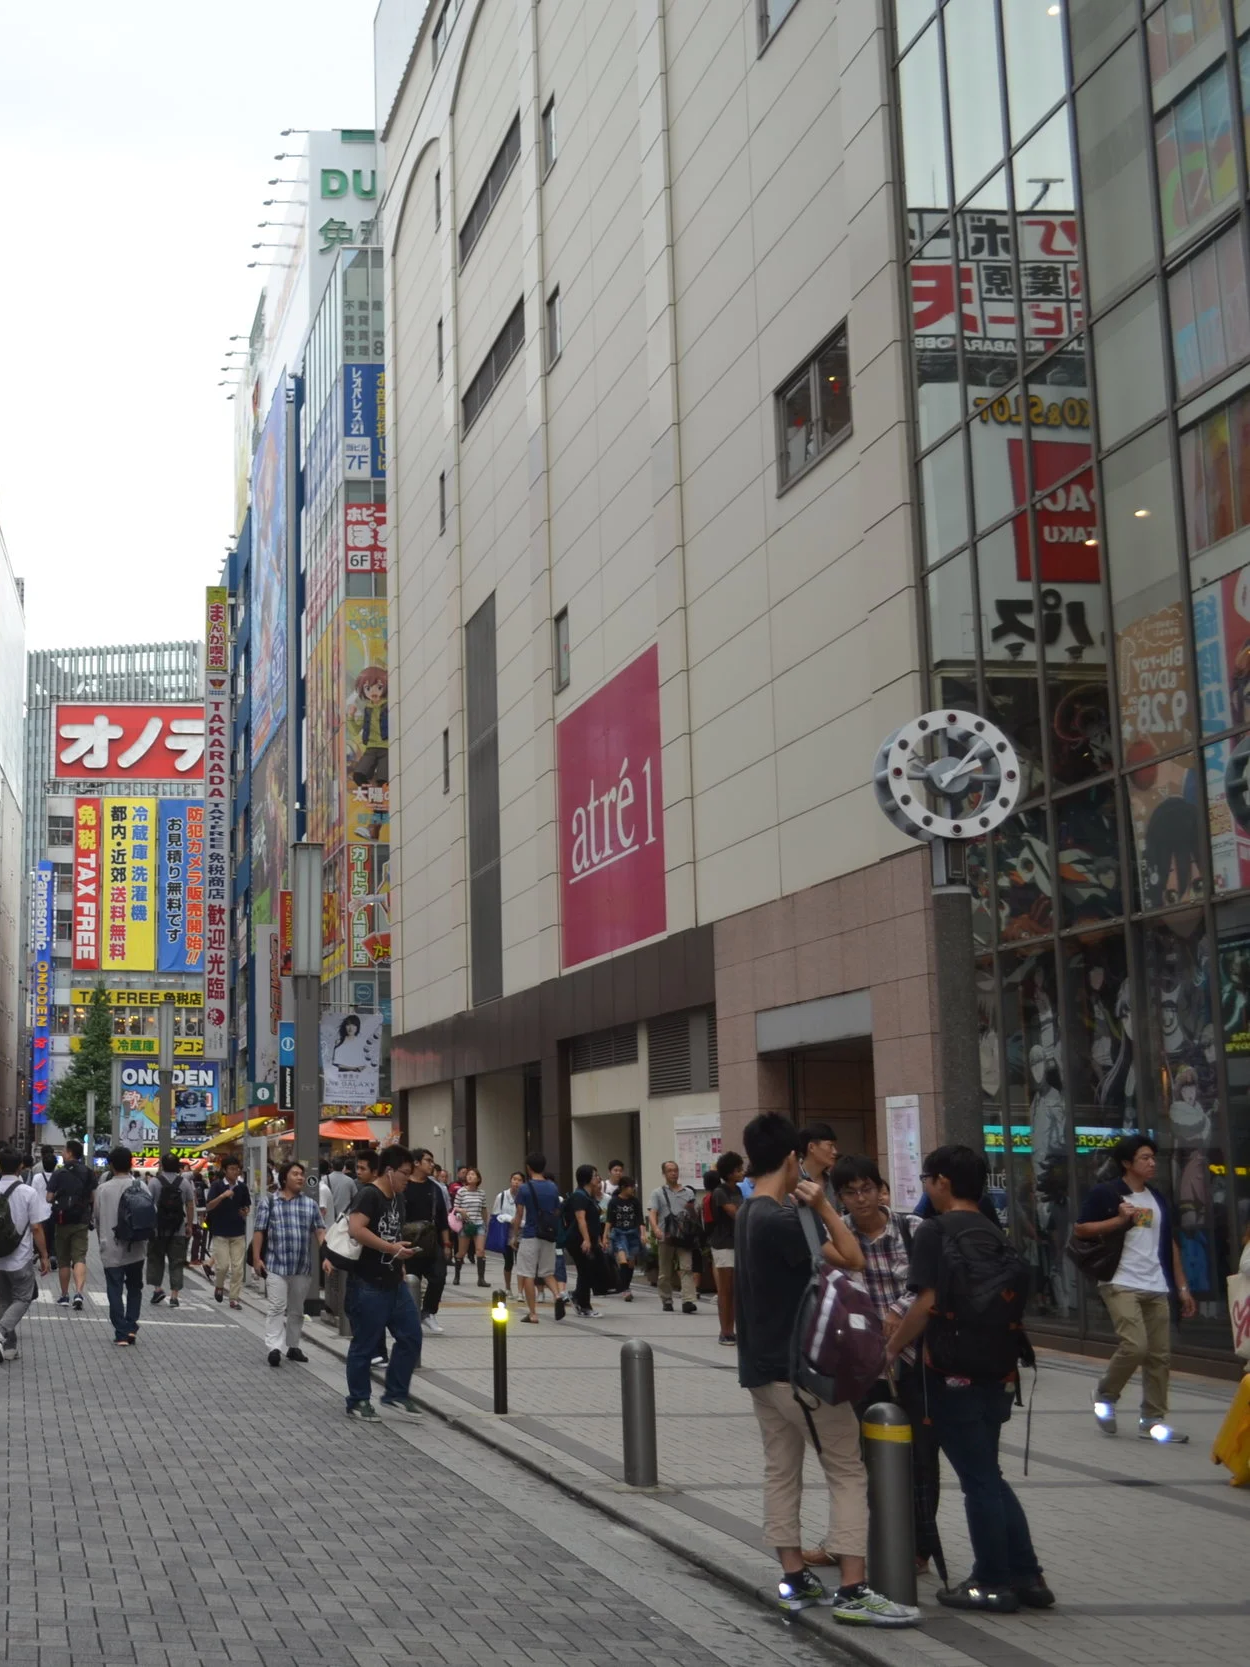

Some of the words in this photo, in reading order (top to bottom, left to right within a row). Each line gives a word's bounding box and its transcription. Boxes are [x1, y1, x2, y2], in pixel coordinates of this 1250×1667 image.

[320, 168, 377, 200] DU
[349, 367, 364, 435] レオパレス21
[345, 454, 369, 471] 7F
[349, 554, 369, 568] 6F
[207, 603, 225, 667] まんが喫茶
[208, 701, 225, 799] TAKARADA
[77, 804, 97, 850] 免税
[571, 756, 635, 876] atré
[641, 755, 657, 846] 1
[77, 852, 97, 898] TAX
[109, 805, 128, 961] 都内・近郊送料無料
[166, 817, 183, 943] お見積り無料です
[207, 851, 226, 901] 免税商店
[37, 869, 51, 952] Panasonic
[76, 901, 97, 961] FREE
[206, 903, 226, 1001] 歓迎光臨
[36, 959, 49, 1028] ONODEN
[117, 991, 162, 1004] FREE
[117, 1039, 155, 1052] 冷蔵庫
